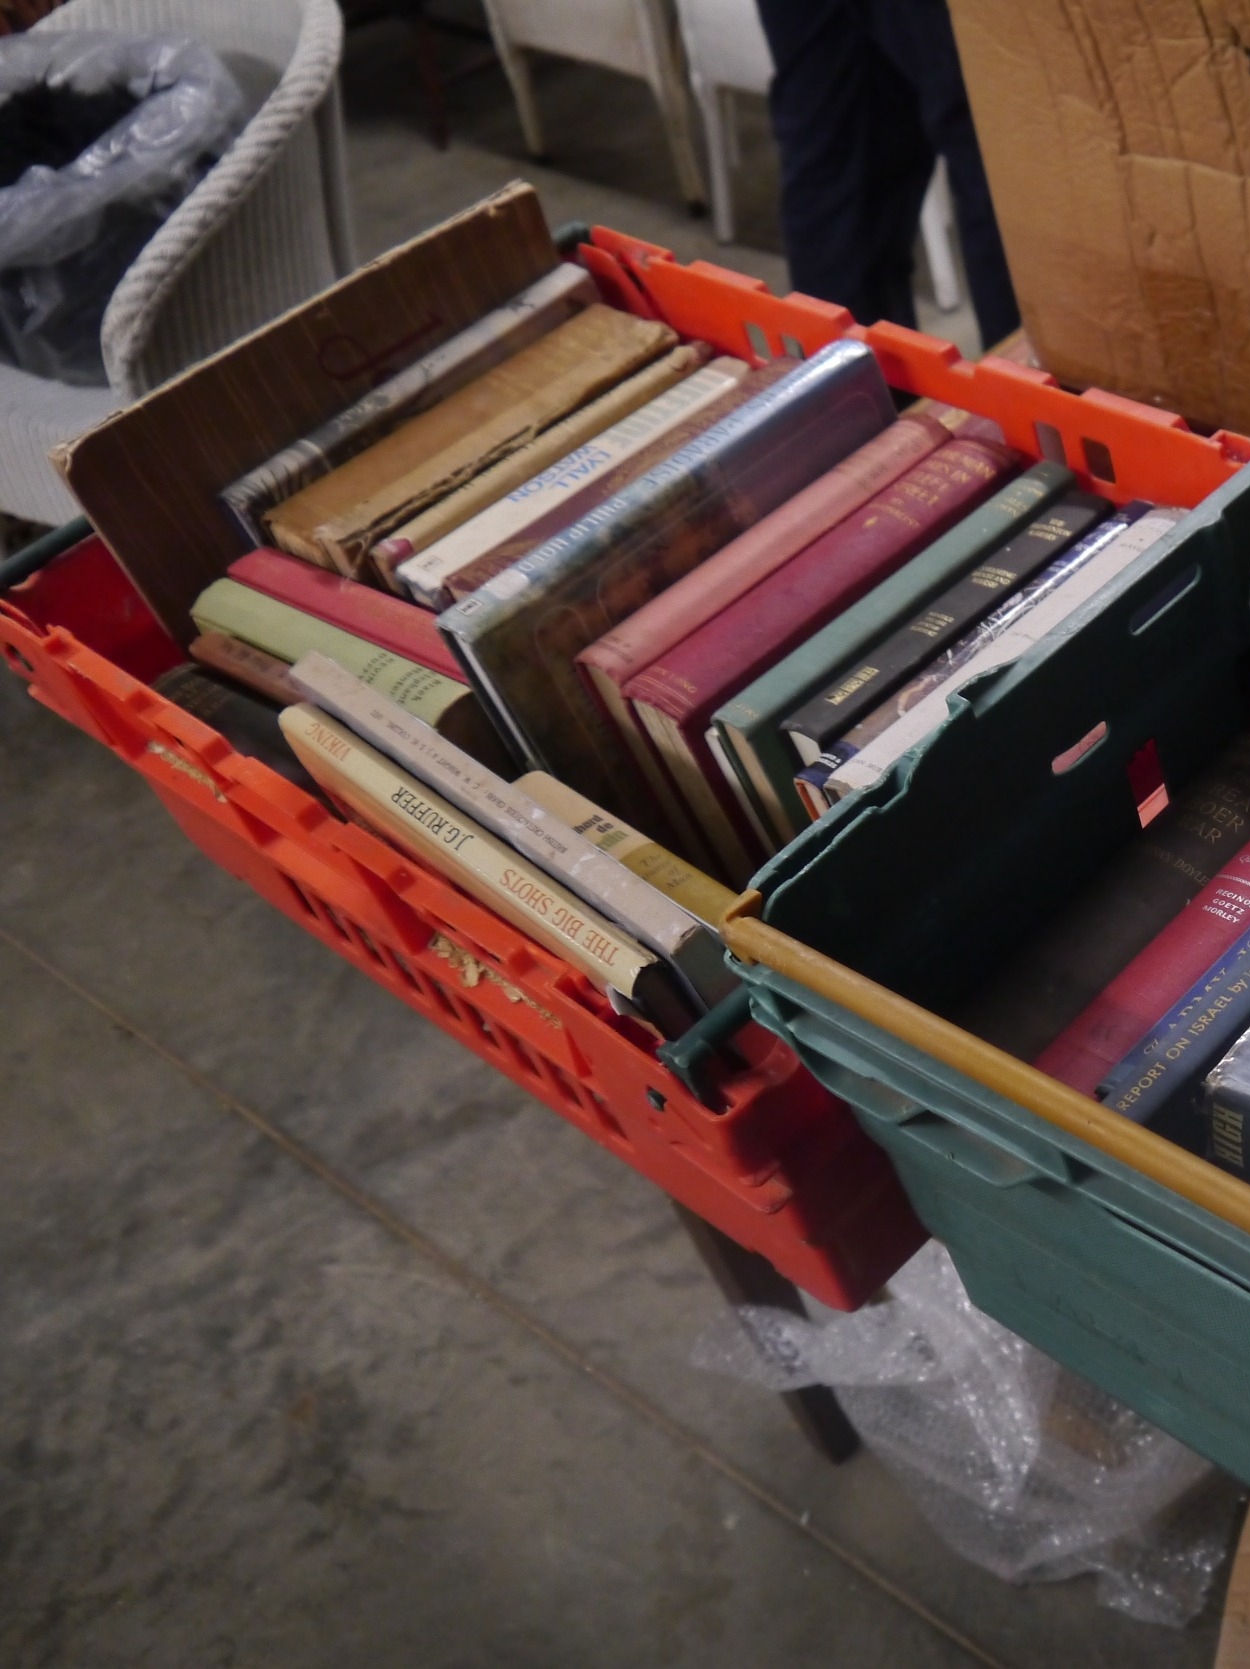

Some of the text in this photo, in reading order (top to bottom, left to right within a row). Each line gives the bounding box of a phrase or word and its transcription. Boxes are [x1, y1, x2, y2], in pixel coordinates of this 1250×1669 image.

[506, 445, 596, 502] WATSON
[556, 450, 611, 488] LYALL
[518, 497, 627, 572] PHILIP HOLD
[305, 721, 351, 762] VIKING
[500, 868, 620, 967] THE BIG SHOTS
[1202, 904, 1242, 924] MORLEY
[1212, 898, 1245, 916] GOETZ
[1115, 1062, 1167, 1111] REPORT
[1165, 1037, 1191, 1060] ON
[1190, 995, 1233, 1036] ISRAEL
[1227, 978, 1249, 999] by
[1212, 1104, 1244, 1169] HIGH
